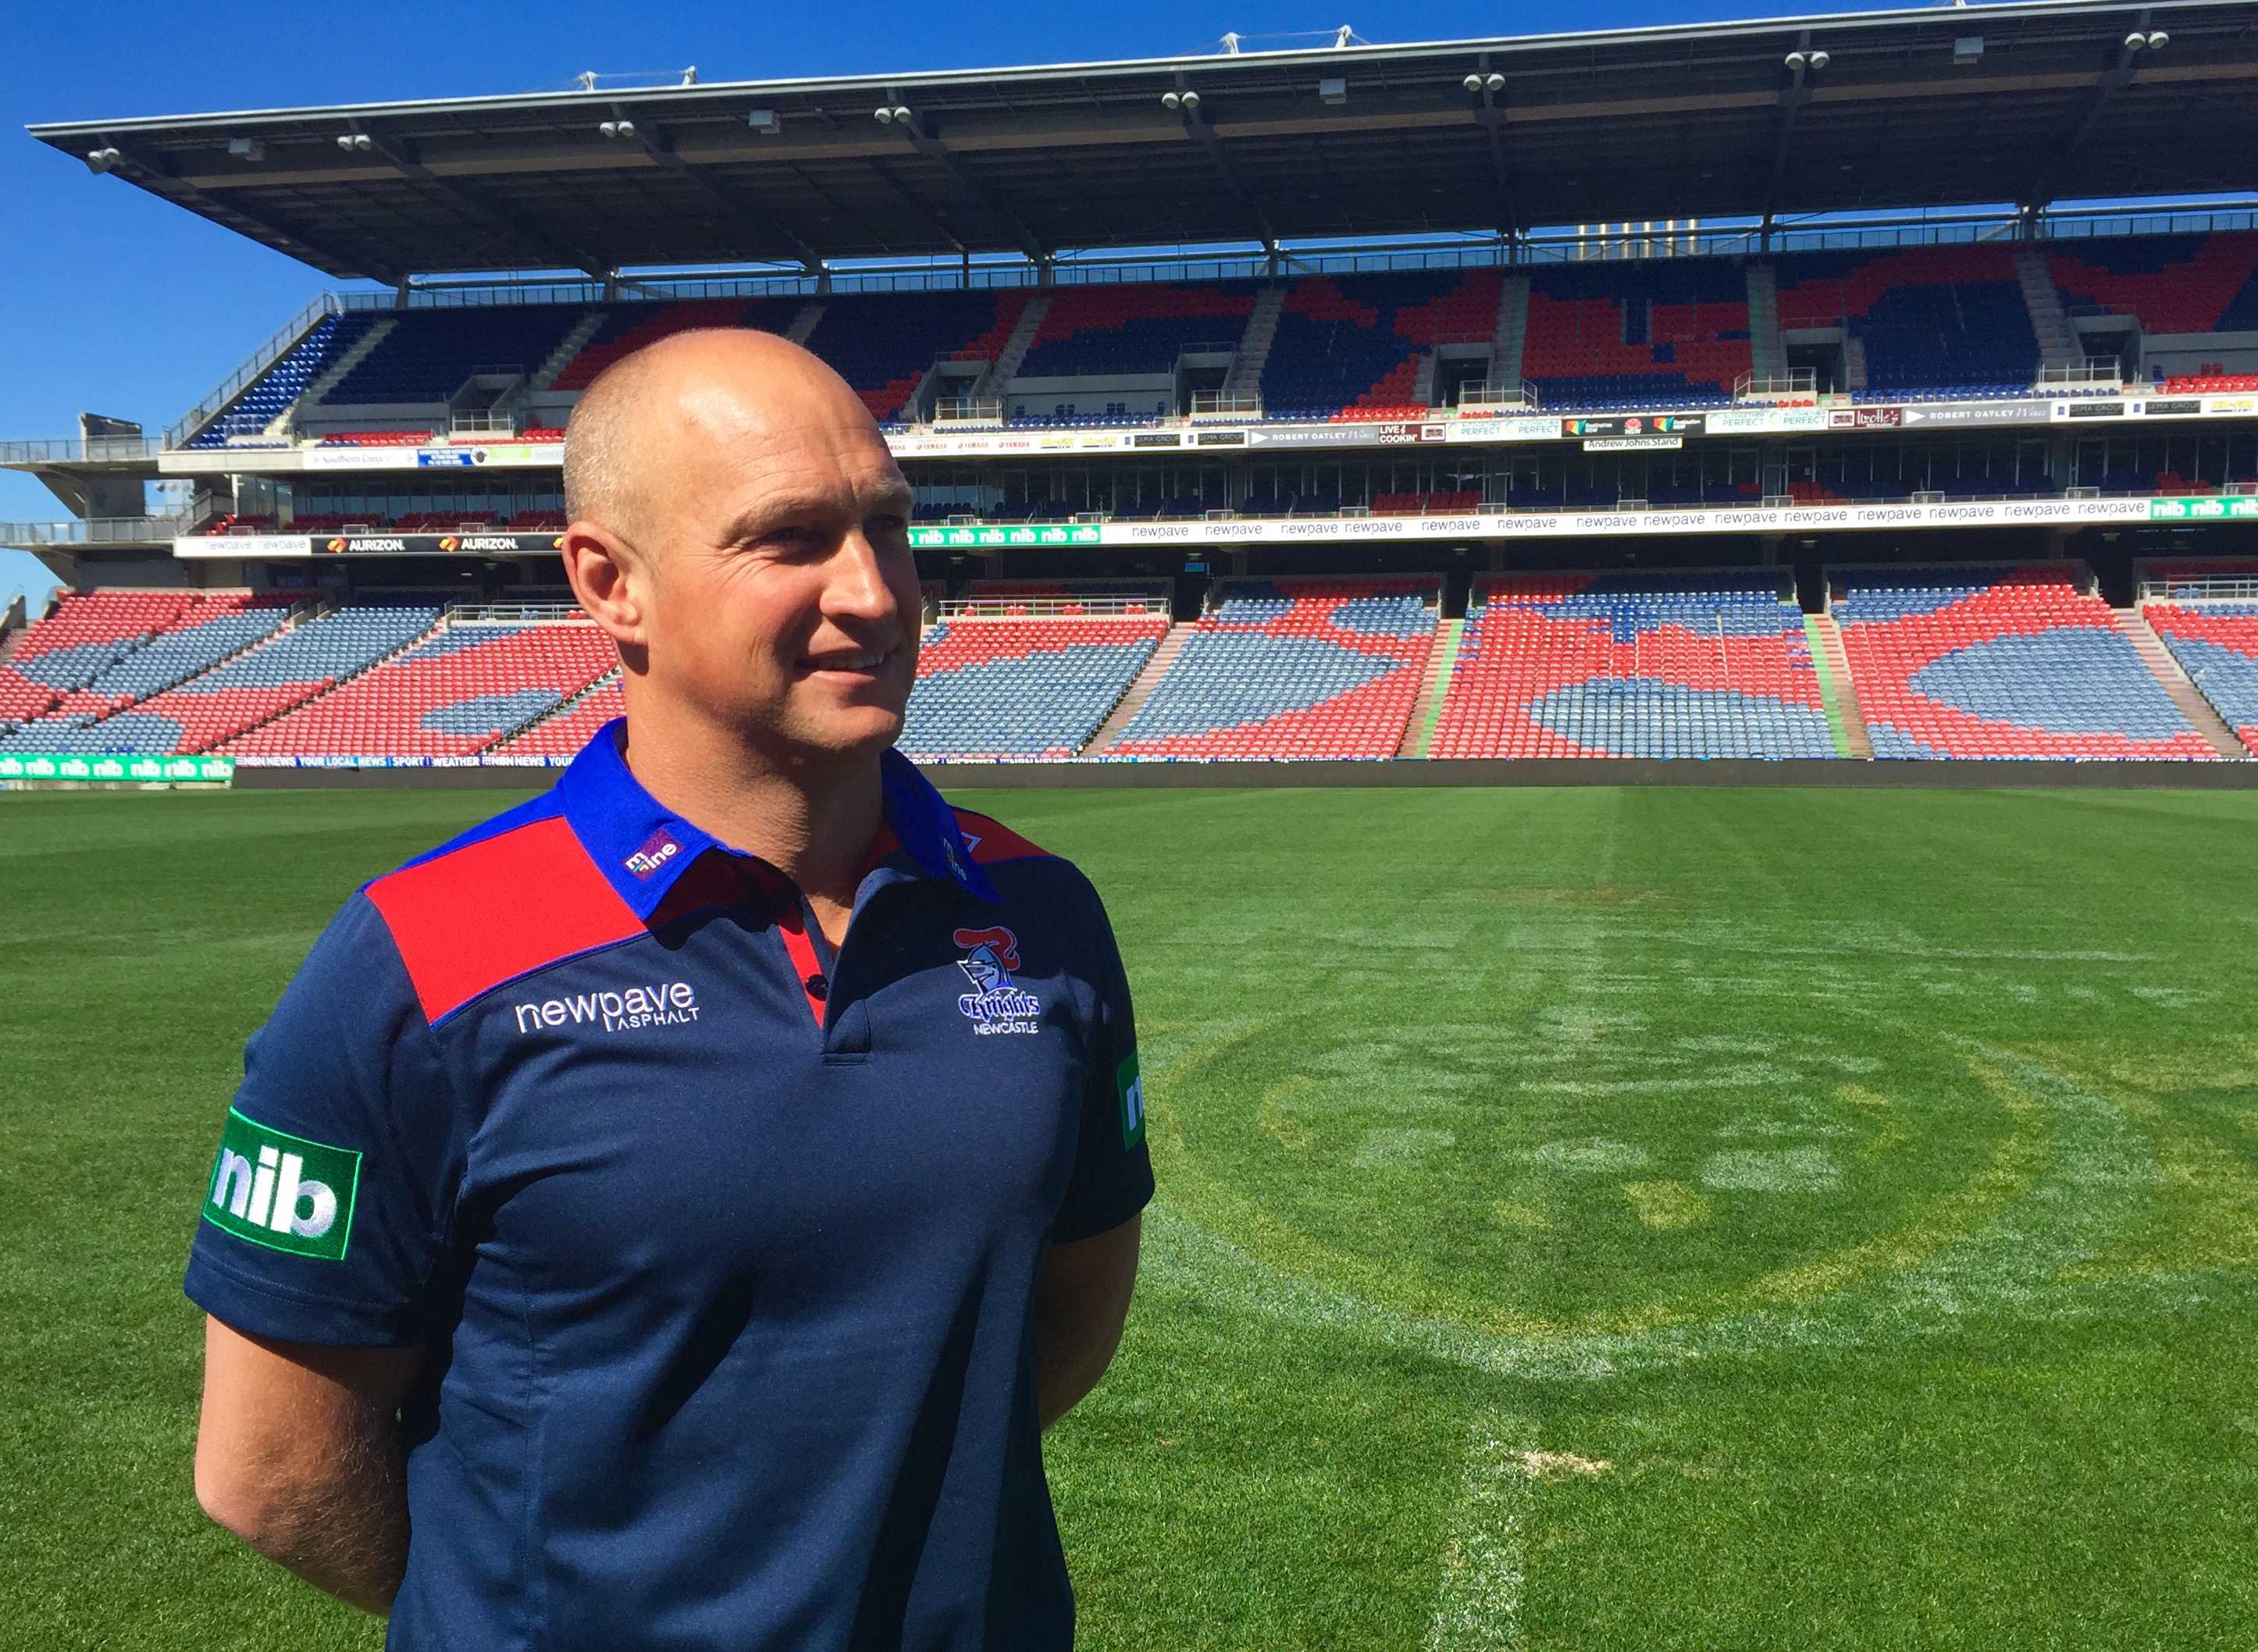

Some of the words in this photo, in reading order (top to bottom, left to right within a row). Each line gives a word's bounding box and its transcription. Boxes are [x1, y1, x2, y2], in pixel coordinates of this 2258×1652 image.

[1723, 418, 1764, 427] PERFECT
[1783, 415, 1825, 425] PERFECT
[1312, 432, 1346, 440] OATLEY
[1380, 425, 1399, 434] LIVE
[1461, 427, 1501, 436] PERFECT
[1518, 425, 1559, 434] PERFECT
[1380, 434, 1419, 443] COOKIN'
[1588, 440, 1623, 449] Andrew
[1625, 438, 1651, 447] Johns
[1653, 437, 1679, 446] Stand
[2154, 501, 2185, 516] nib
[2192, 500, 2224, 515] nib
[1132, 526, 1188, 539] newpave
[1206, 525, 1263, 537] newpave
[1281, 523, 1338, 536] newpave
[1344, 522, 1402, 536] newpave
[1422, 520, 1480, 533] newpave
[1498, 518, 1557, 532] newpave
[1576, 517, 1637, 530] newpave
[1644, 514, 1705, 529] newpave
[1715, 513, 1777, 527] newpave
[1785, 511, 1847, 525] newpave
[1857, 509, 1921, 523] newpave
[1929, 507, 1994, 522] newpave
[2005, 504, 2070, 518] newpave
[2078, 501, 2145, 516] newpave
[919, 530, 945, 544] nib
[949, 529, 974, 544] nib
[980, 529, 1006, 543] nib
[1010, 528, 1036, 543] nib
[1042, 528, 1067, 543] nib
[1072, 527, 1099, 542] nib
[25, 758, 55, 776] nib
[59, 759, 90, 777] nib
[93, 760, 123, 777] nib
[130, 760, 161, 777] nib
[165, 760, 197, 778] nib
[201, 760, 233, 778] nib
[267, 757, 295, 767] NEWS
[299, 757, 324, 767] YOUR
[326, 757, 358, 767] LOCAL
[358, 757, 386, 767] NEWS
[393, 757, 424, 767] SPORT
[433, 757, 479, 767] WEATHER
[492, 757, 514, 766] NBN
[515, 757, 545, 766] NEWS
[515, 982, 694, 1034] newpave
[959, 990, 1041, 1023] Knights
[618, 1007, 700, 1031] ASPHALT
[974, 1021, 1038, 1035] NEWCASTLE
[212, 1145, 337, 1238] nib
